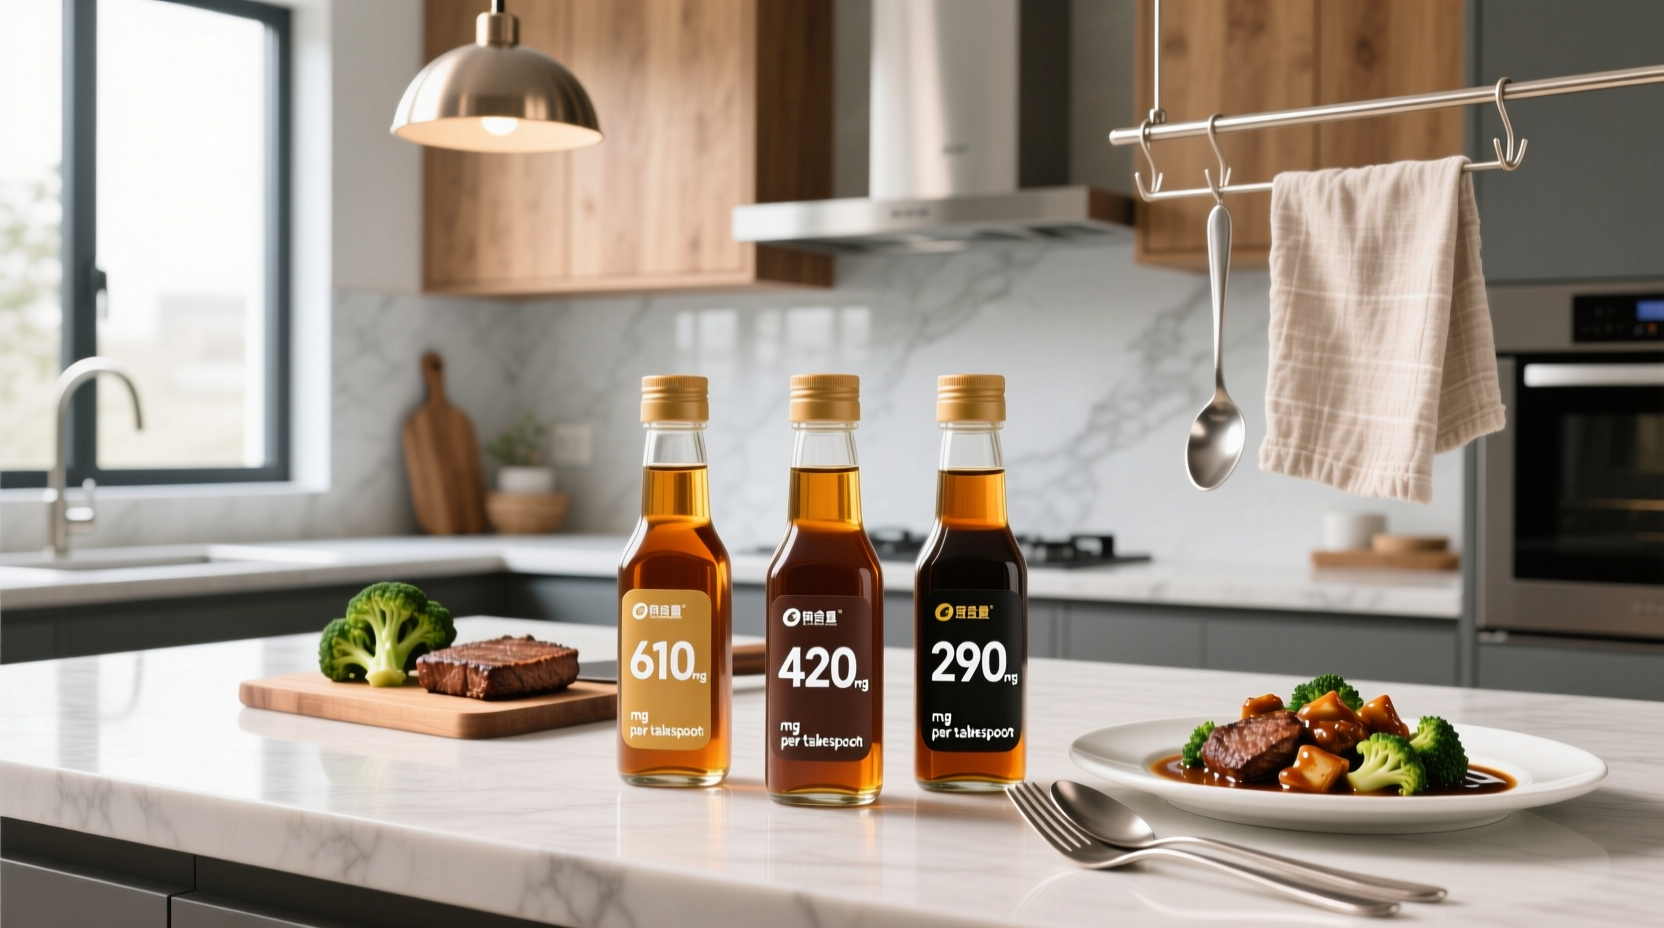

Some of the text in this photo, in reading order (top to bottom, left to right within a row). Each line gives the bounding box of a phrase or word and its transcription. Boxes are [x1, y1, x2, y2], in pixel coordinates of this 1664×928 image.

[630, 640, 695, 681] 610
[778, 646, 857, 689] 420
[931, 641, 1007, 682] 290
[630, 711, 649, 724] mg
[932, 712, 952, 727] mg
[630, 726, 649, 740] per
[780, 722, 800, 736] mg
[931, 728, 952, 741] per
[781, 737, 801, 751] per
